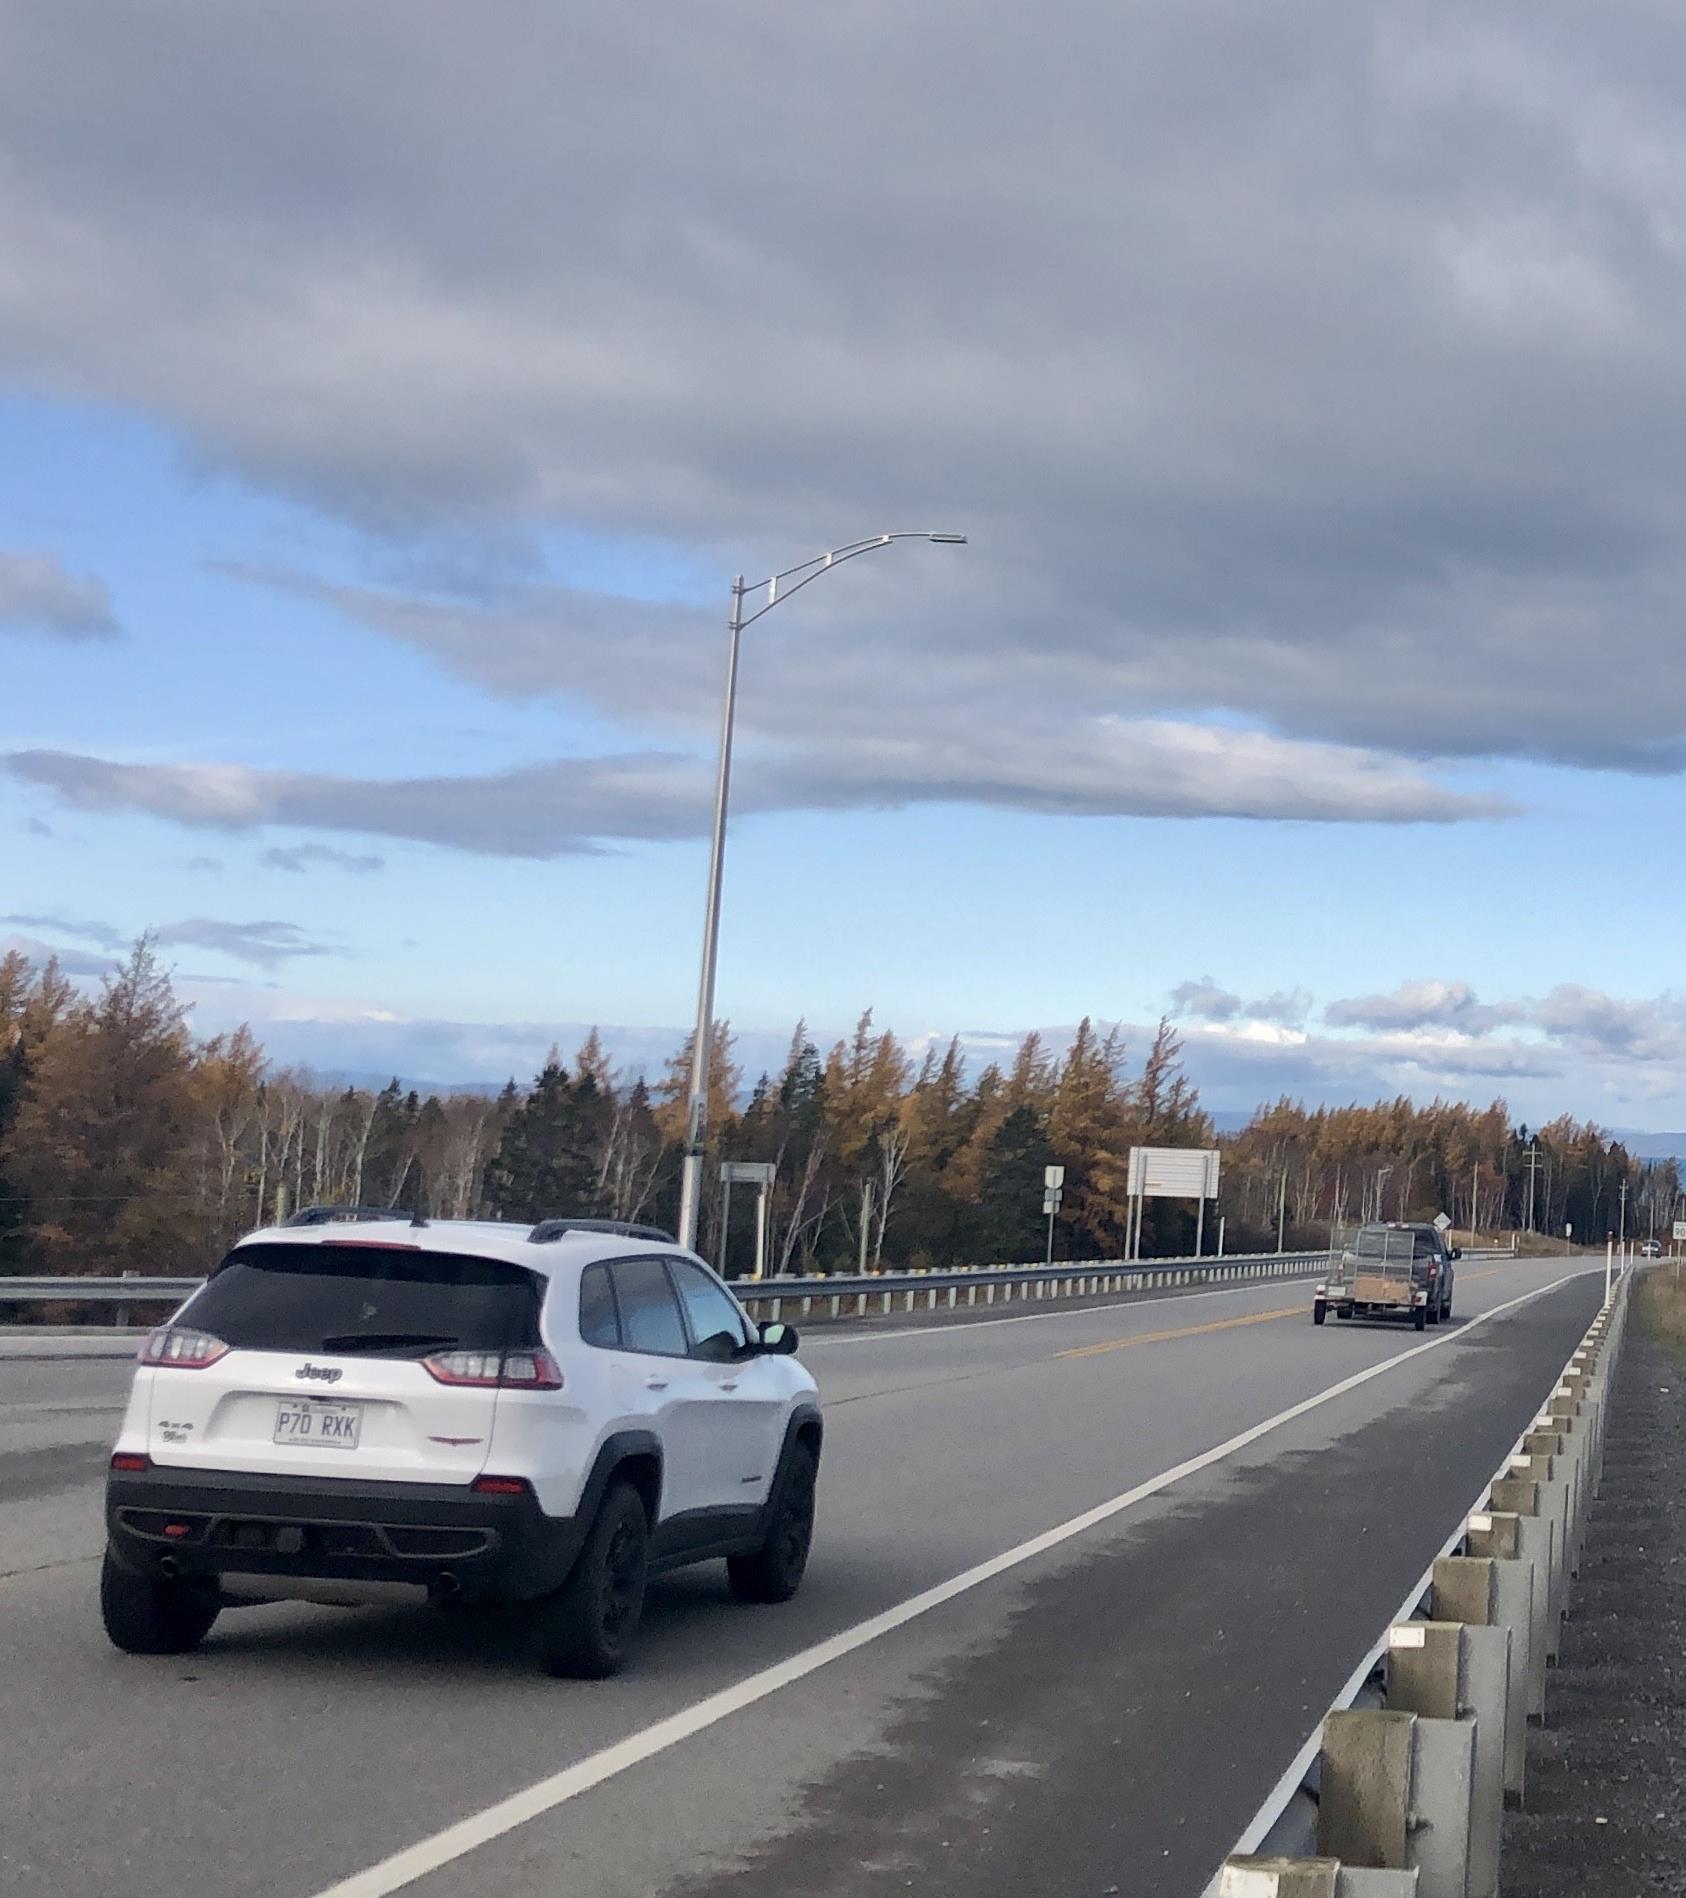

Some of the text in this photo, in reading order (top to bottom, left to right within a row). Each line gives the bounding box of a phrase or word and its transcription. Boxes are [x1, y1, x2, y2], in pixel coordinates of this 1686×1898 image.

[295, 1362, 343, 1384] Jeep
[278, 1412, 355, 1437] P70 RXK
